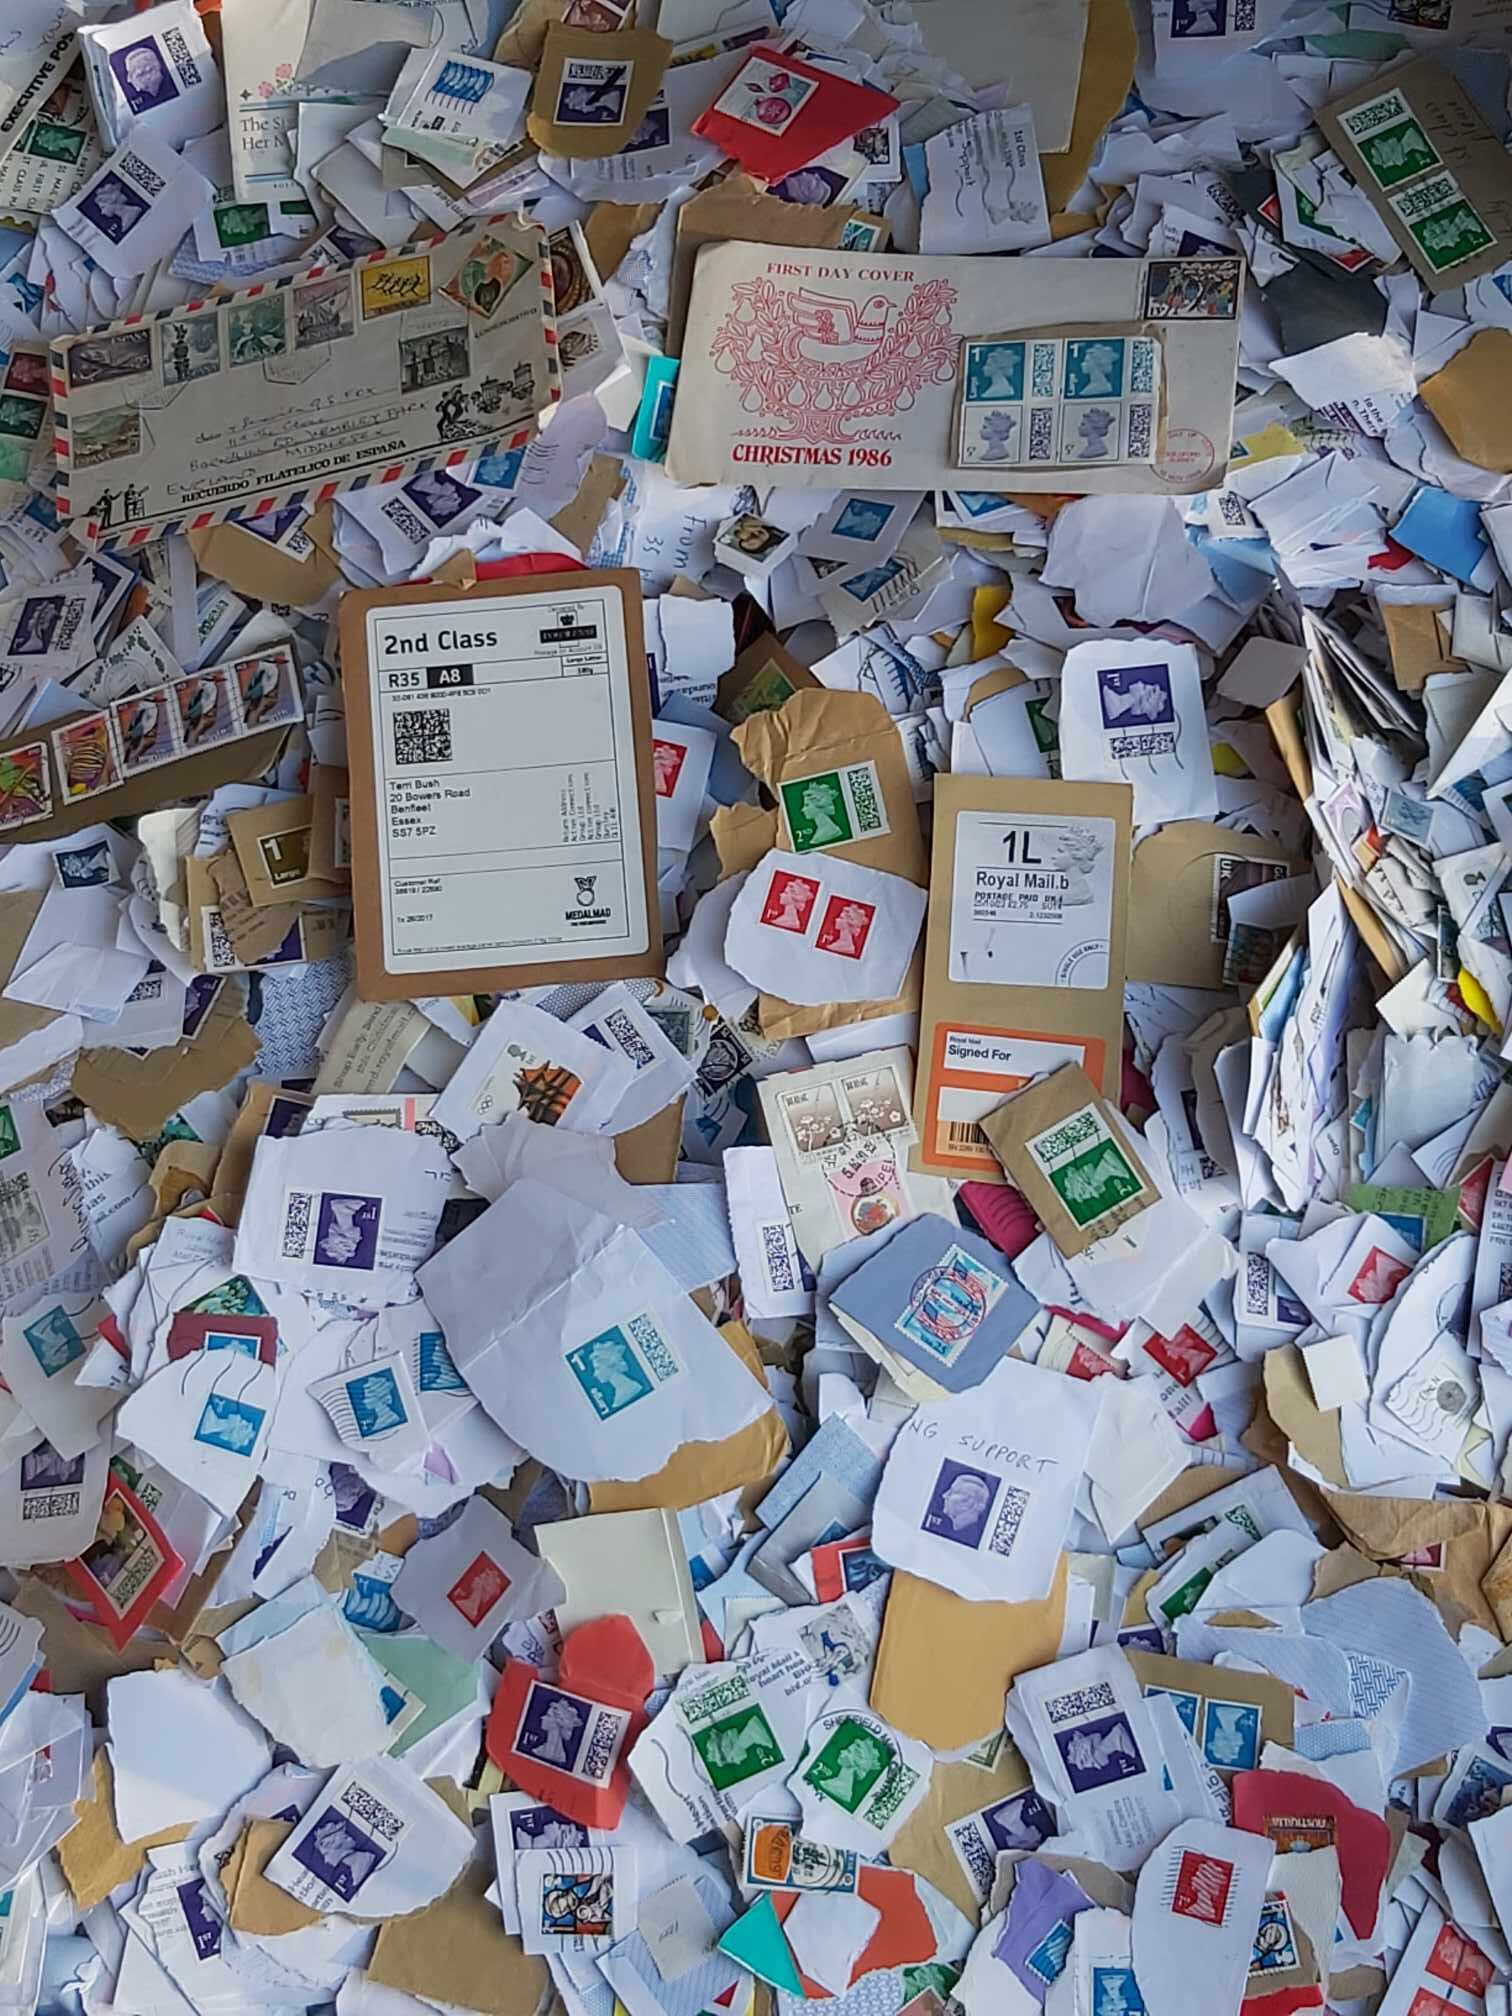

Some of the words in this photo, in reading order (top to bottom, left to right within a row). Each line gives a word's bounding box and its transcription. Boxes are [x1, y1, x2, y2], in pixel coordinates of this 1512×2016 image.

[1, 61, 56, 132] EXECUTIVE
[241, 117, 268, 132] The
[242, 137, 270, 150] Her
[767, 262, 812, 277] FIRST
[818, 266, 850, 280] DAY
[858, 268, 914, 283] COVER
[732, 444, 842, 466] CHRISTMAS
[847, 448, 893, 467] 1986
[181, 478, 250, 504] RECUERDO
[255, 458, 331, 486] FILATELICO
[332, 451, 352, 467] DE
[356, 439, 408, 461] ESPAÑA
[384, 632, 430, 655] 2nd
[437, 629, 498, 651] Class
[388, 671, 420, 688] R35
[439, 668, 461, 685] A8
[415, 778, 440, 790] Bush
[390, 793, 402, 803] 20
[405, 790, 442, 802] Bowers
[445, 787, 471, 798] Road
[391, 803, 432, 815] Benfleet
[392, 816, 422, 827] Essex
[392, 828, 412, 839] SS7
[415, 825, 436, 837] 5PZ
[264, 837, 283, 861] 1
[1002, 830, 1042, 864] 1L
[1221, 860, 1233, 880] UK
[976, 871, 1019, 890] Royal
[975, 891, 1013, 901] POSTAGE
[1018, 893, 1039, 902] PAID
[565, 907, 612, 921] MEDALMAD
[948, 1045, 989, 1060] Signed
[991, 1049, 1012, 1062] For
[958, 1434, 1060, 1475] SUPPORT
